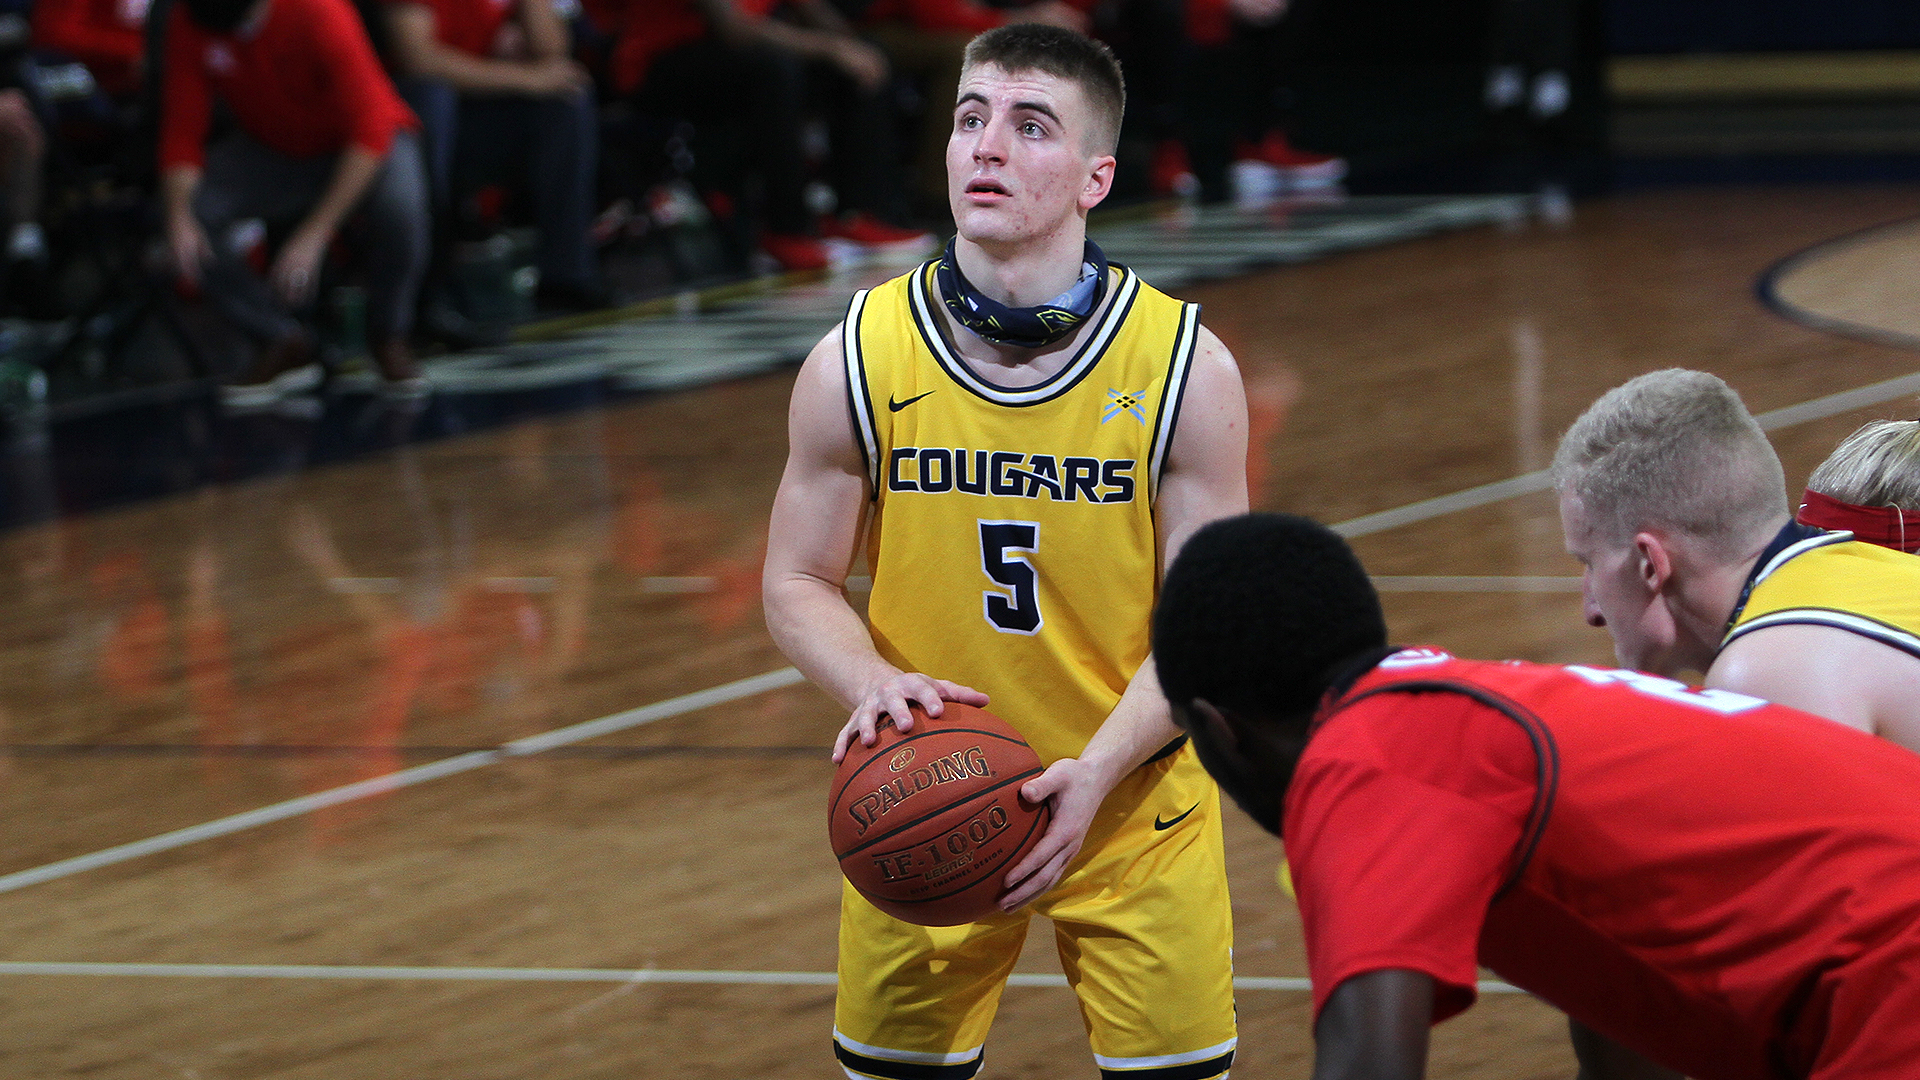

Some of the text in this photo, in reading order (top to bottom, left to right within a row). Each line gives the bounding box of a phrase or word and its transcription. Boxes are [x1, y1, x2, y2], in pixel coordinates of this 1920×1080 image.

[888, 447, 1136, 504] COUGARS
[977, 518, 1044, 636] 5
[849, 746, 992, 836] SPALDING
[874, 806, 1008, 879] TF-1000
[924, 849, 976, 882] LEGACY
[932, 869, 972, 888] CHANNEL
[973, 848, 1004, 870] DESIGN
